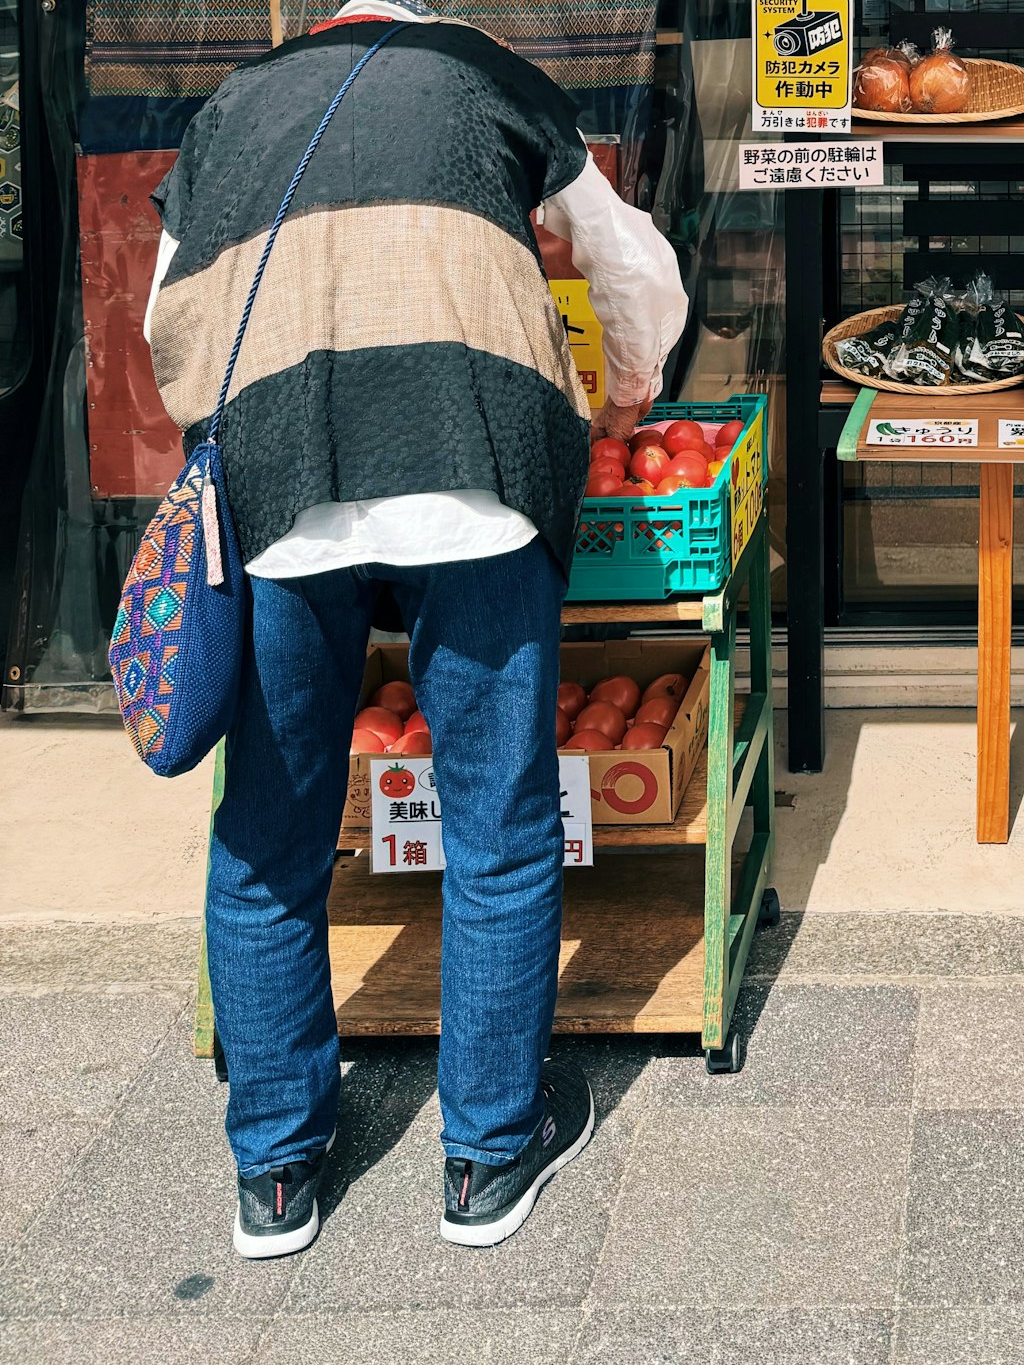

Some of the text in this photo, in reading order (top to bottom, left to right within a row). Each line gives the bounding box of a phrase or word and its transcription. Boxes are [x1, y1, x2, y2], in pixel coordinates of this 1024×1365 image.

[765, 60, 841, 75] 防犯カメラ
[775, 80, 833, 99] 作動中
[761, 116, 850, 129] 万引きは犯罪です
[743, 146, 877, 165] 野菜の前の駐輪は
[753, 166, 869, 184] ご遠慮ください
[907, 435, 972, 444] 160円
[381, 833, 428, 867] 1箱
